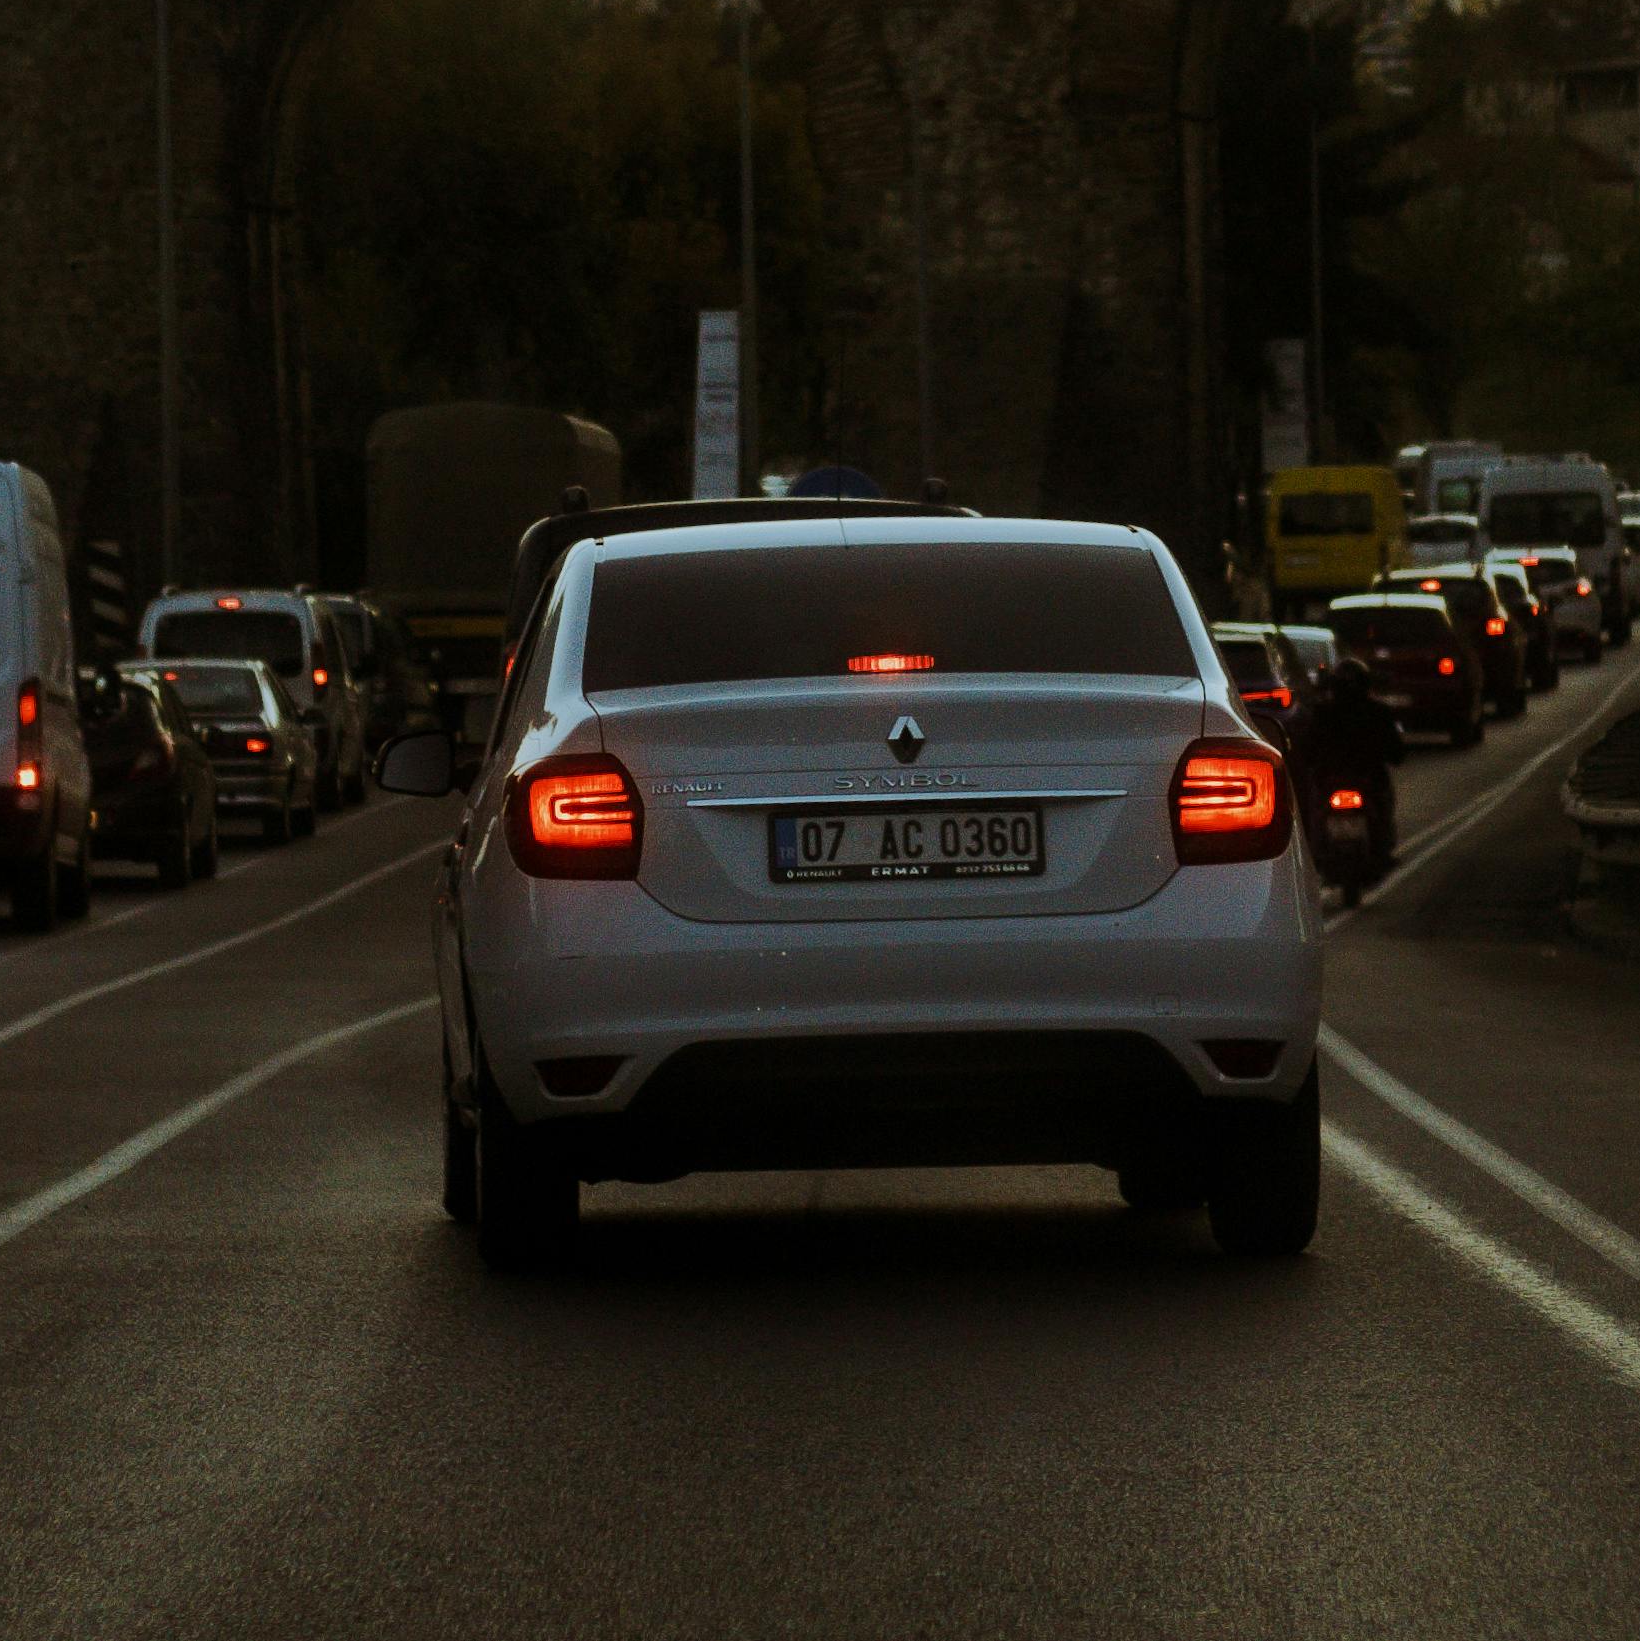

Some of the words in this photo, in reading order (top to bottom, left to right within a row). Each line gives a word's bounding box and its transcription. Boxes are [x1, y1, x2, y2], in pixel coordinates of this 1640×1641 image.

[650, 782, 726, 796] RENAULT
[834, 773, 979, 790] SYMBOL
[801, 821, 844, 862] 07
[877, 818, 921, 861] AC
[937, 815, 1030, 859] 0360
[871, 864, 930, 877] ERMAT
